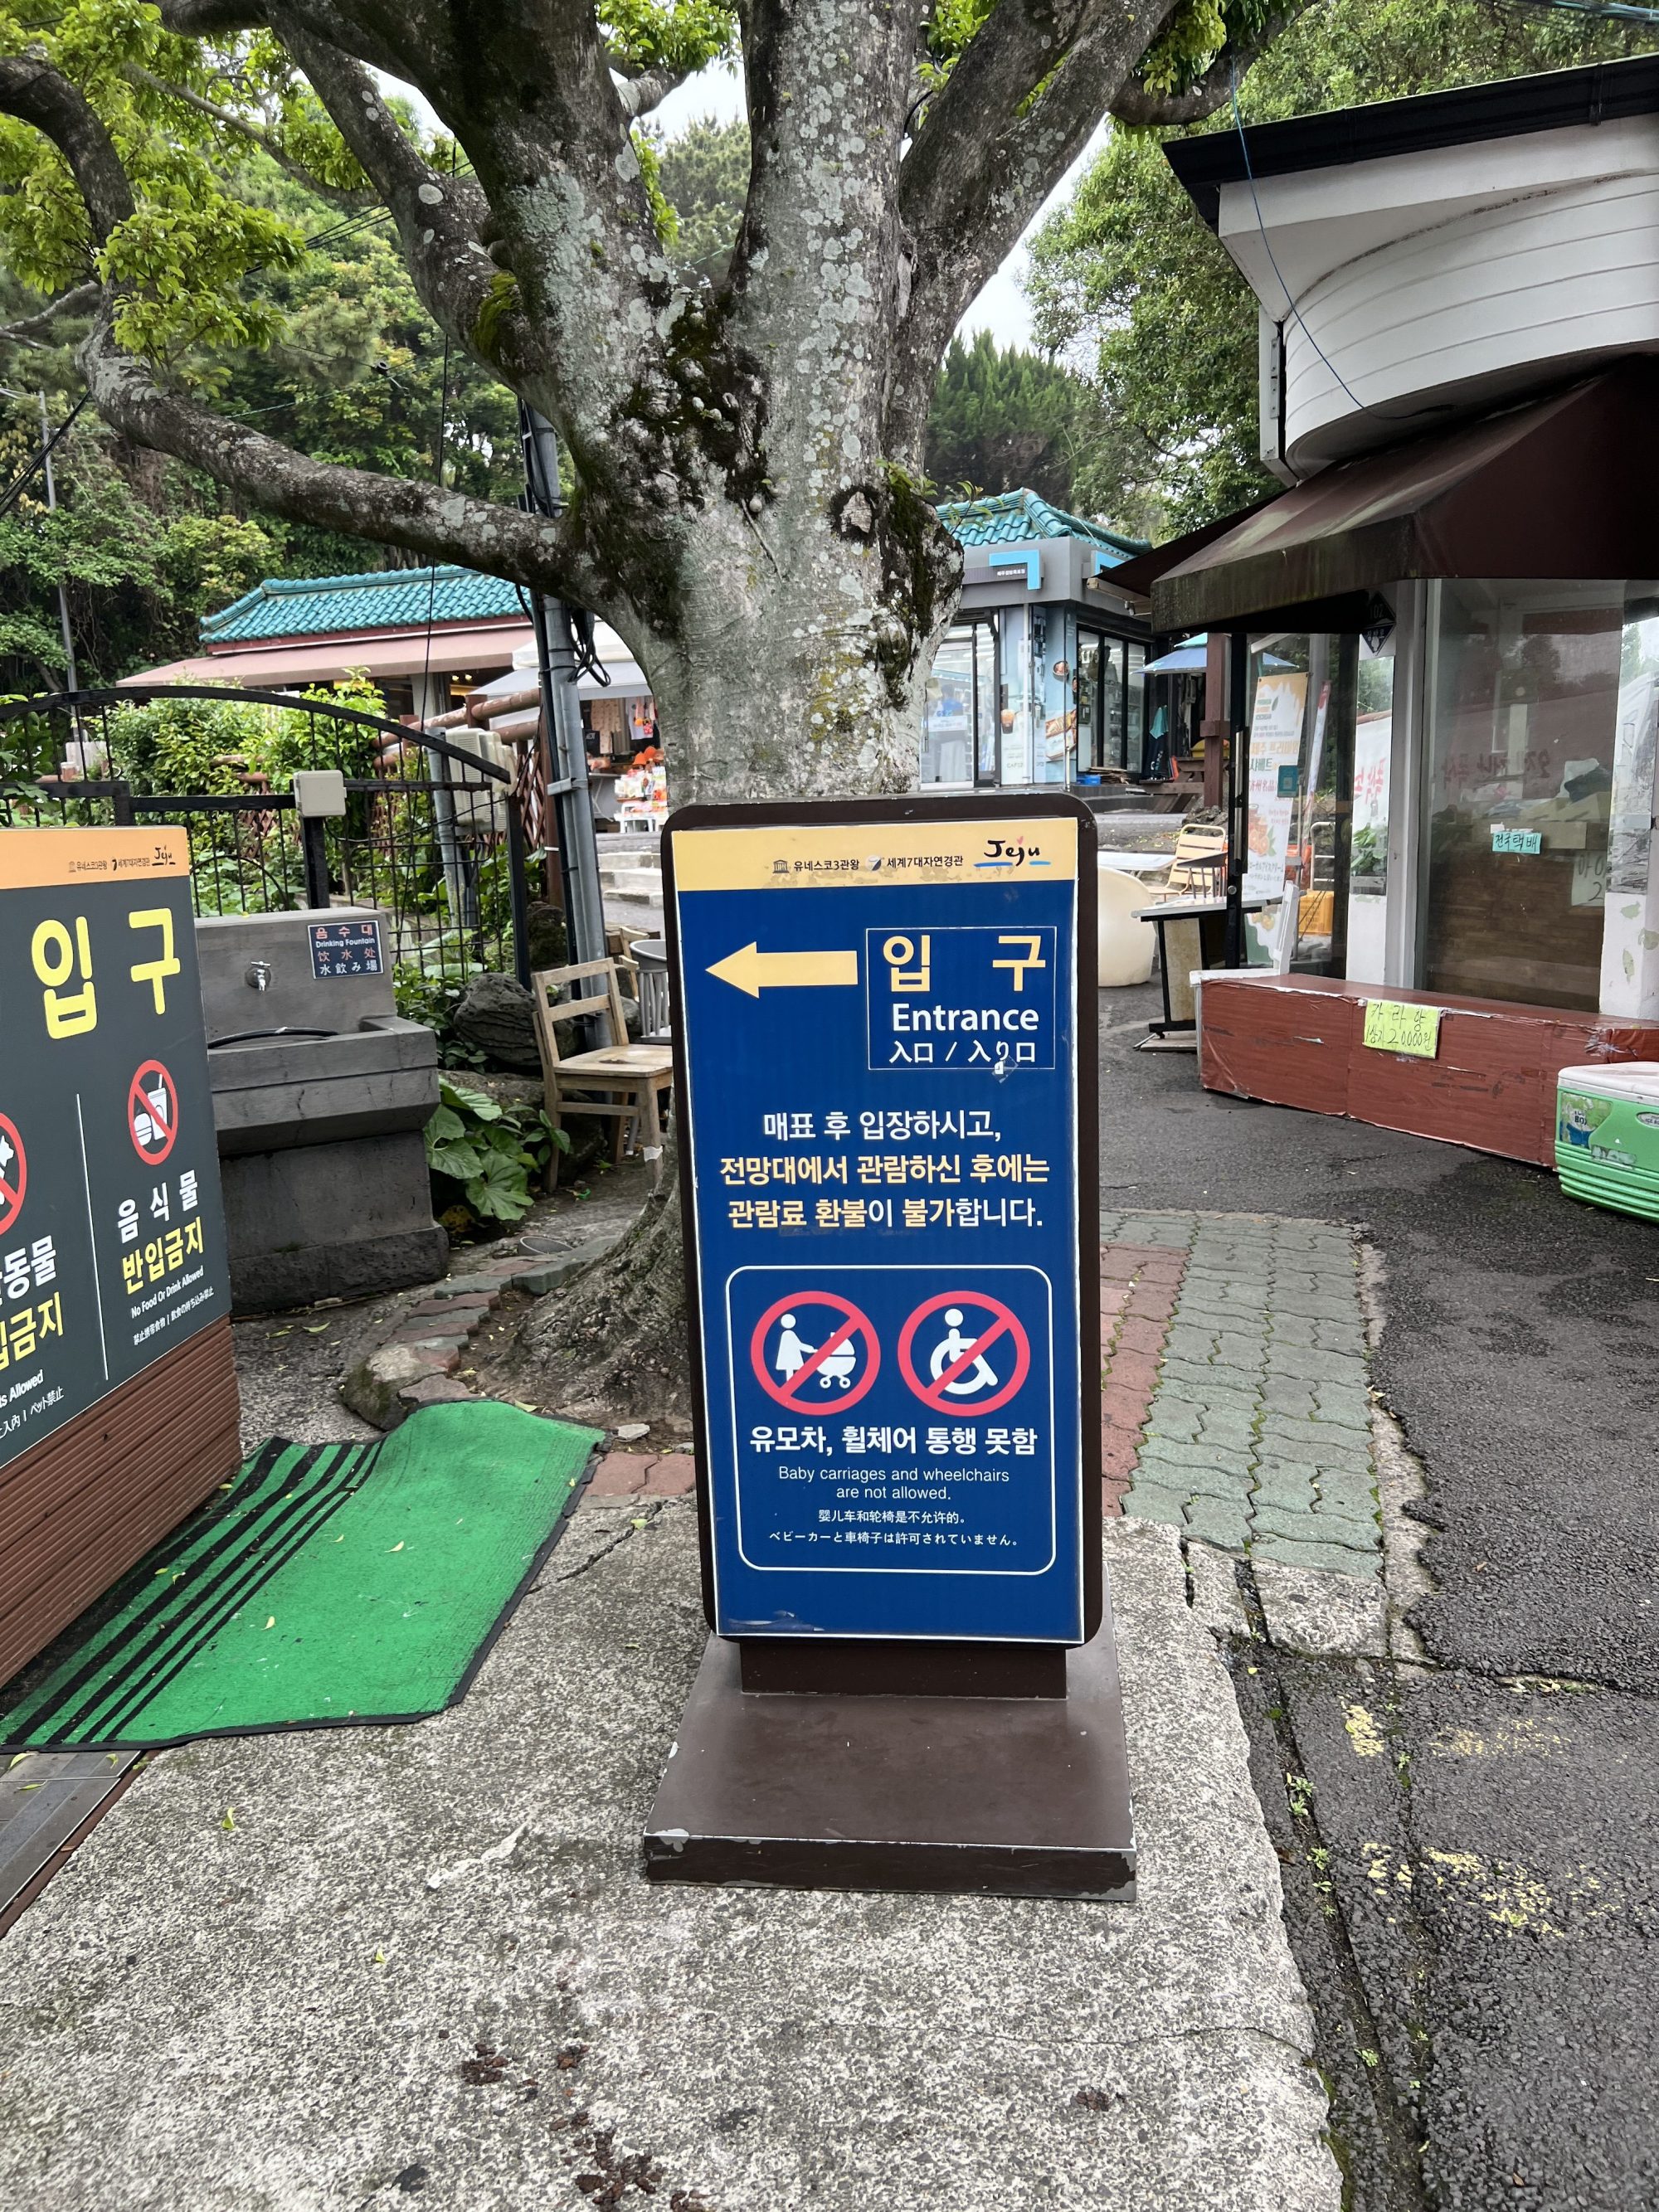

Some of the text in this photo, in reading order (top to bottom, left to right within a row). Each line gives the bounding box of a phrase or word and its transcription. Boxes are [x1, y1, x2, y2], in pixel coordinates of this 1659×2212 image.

[794, 837, 1041, 872] 유네스코3관왕 세계7대자연경관 Jeju
[315, 936, 376, 949] Drinking Fountain
[893, 1003, 1039, 1032] Entrance
[888, 1039, 934, 1064] 入口
[967, 1038, 1036, 1063] 入り口
[763, 1110, 1002, 1142] 매표 후 입장하시고,
[719, 1153, 1050, 1186] 전망대에서 관람하신 후에는
[727, 1198, 1044, 1229] 관람료 환불이 불가합니다.
[0, 1234, 57, 1305] 동물
[122, 1216, 204, 1296] 반입금지
[131, 1264, 205, 1320] No Food Or Drink Allowed
[9, 1369, 44, 1403] Allowed
[750, 1426, 1038, 1456] 유모차, 휠체어 통행 못함
[778, 1466, 1010, 1484] Baby carriages and wheelchairs
[836, 1486, 952, 1500] are not allowed.
[818, 1509, 966, 1524] 婴儿车和轮椅是不允许的。
[769, 1531, 1018, 1547] ベビーカーと車椅子は許可されていません。
